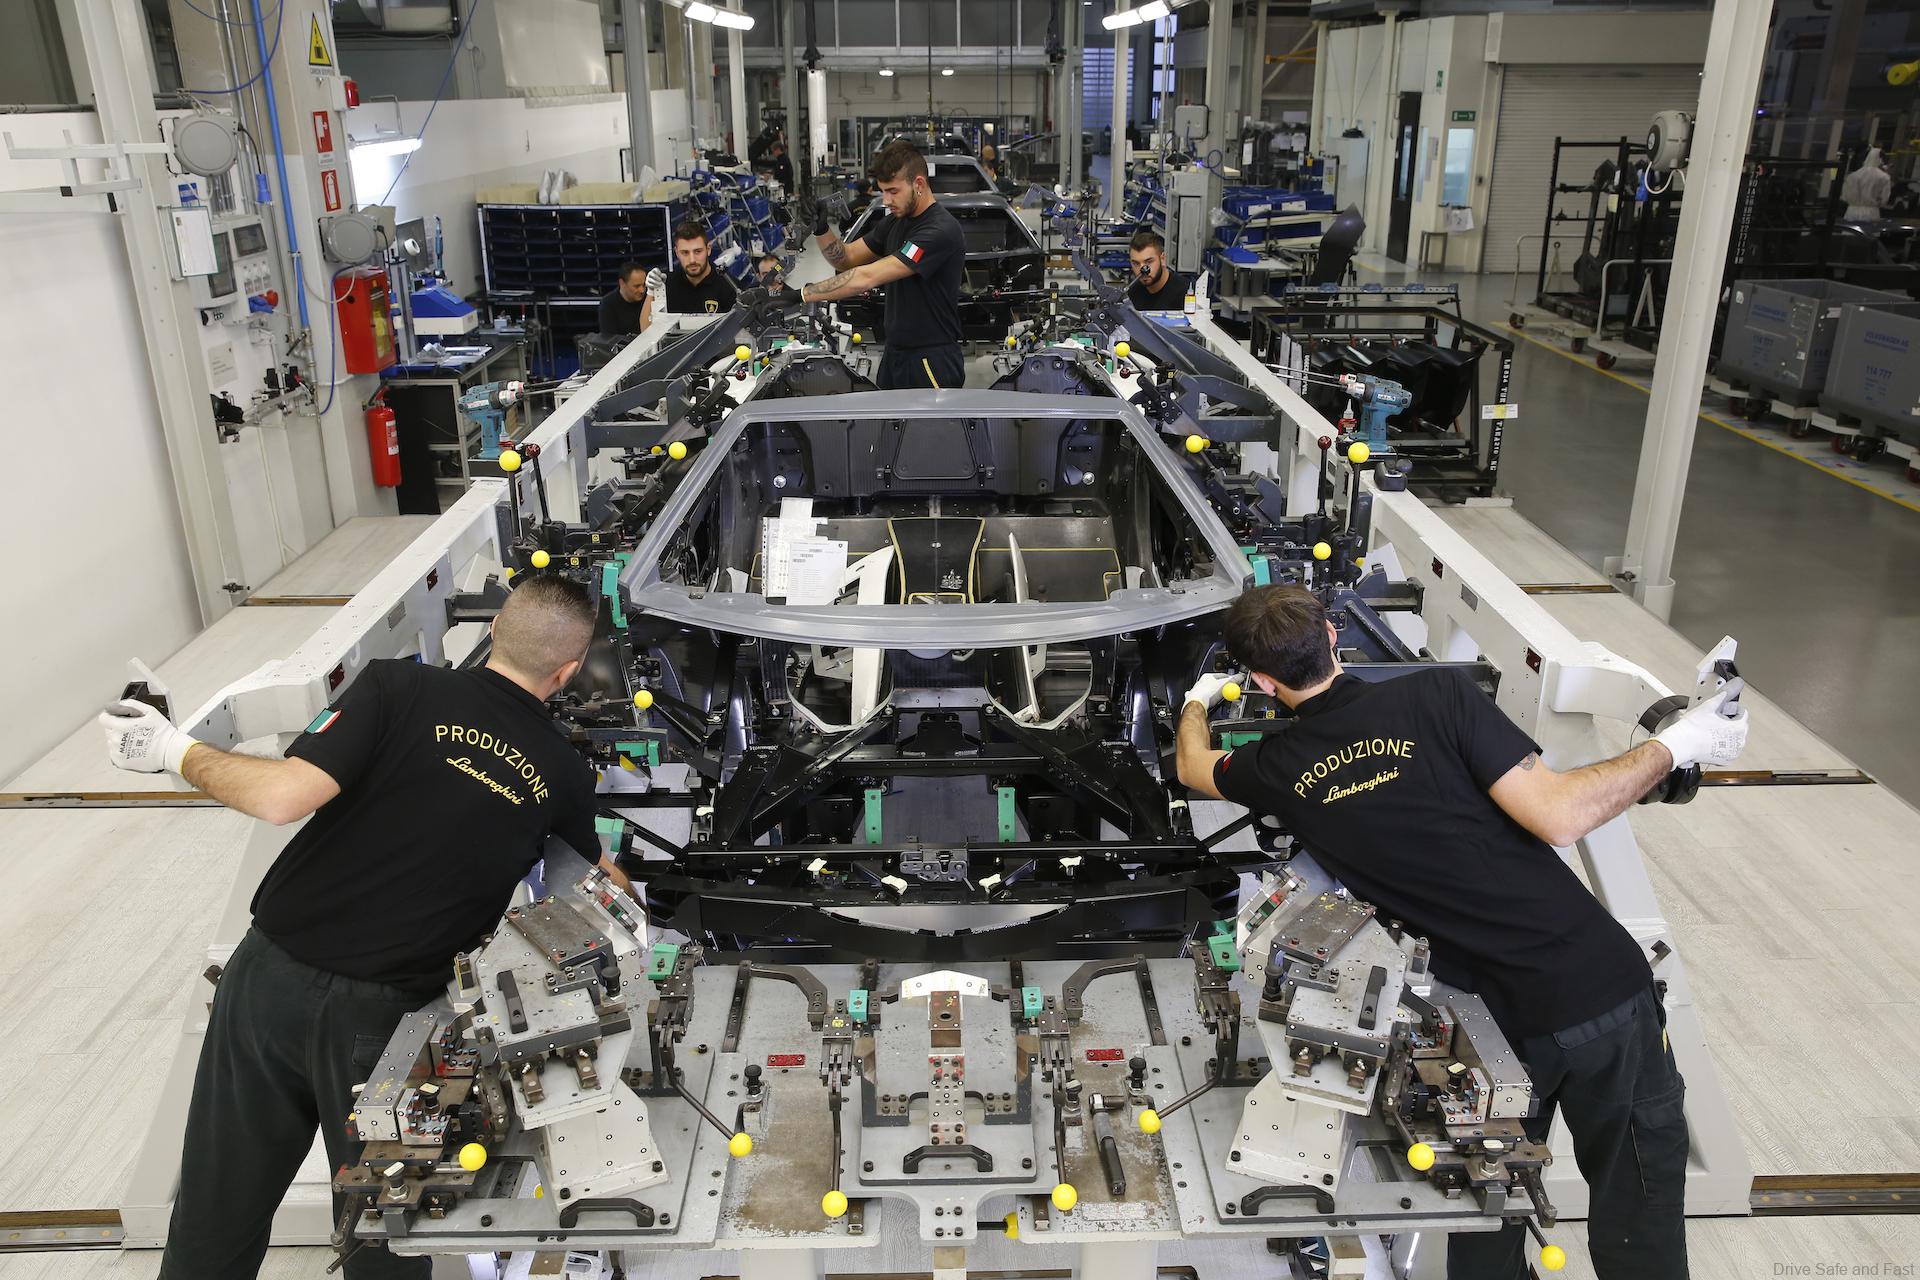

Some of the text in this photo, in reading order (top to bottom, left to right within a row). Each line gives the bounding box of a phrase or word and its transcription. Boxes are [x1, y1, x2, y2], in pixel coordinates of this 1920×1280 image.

[1866, 364, 1893, 379] 114 777
[119, 732, 130, 754] MAPA
[435, 725, 549, 805] PRODUZIONE
[446, 757, 525, 805] Lamborghini
[1294, 738, 1415, 799] PRODUZIONE
[1322, 766, 1400, 804] Lamborghini
